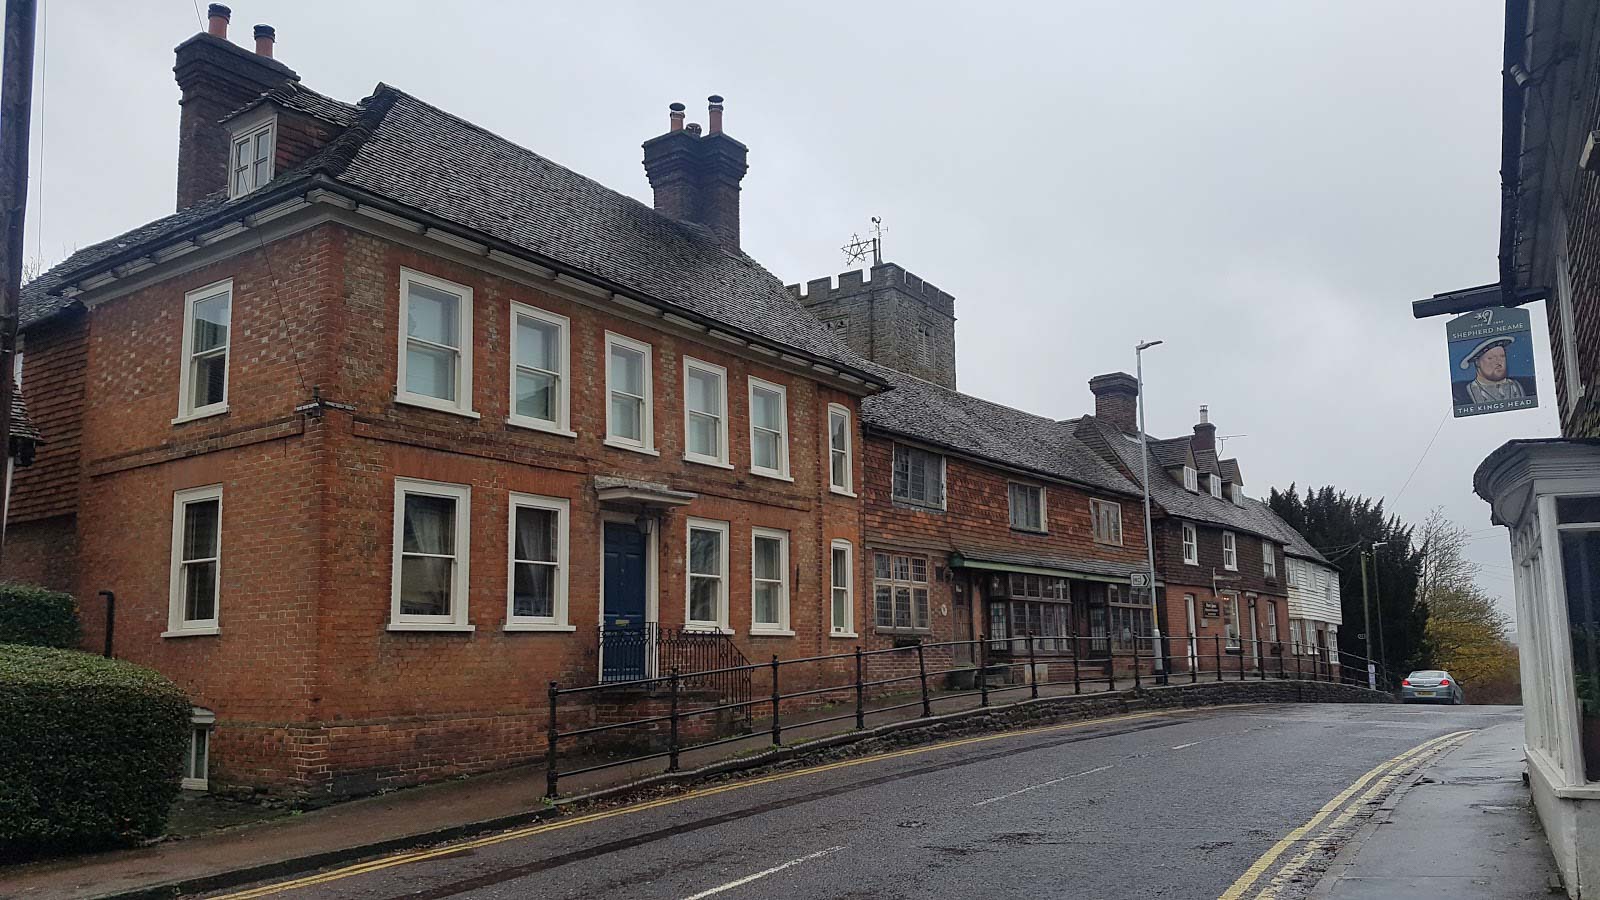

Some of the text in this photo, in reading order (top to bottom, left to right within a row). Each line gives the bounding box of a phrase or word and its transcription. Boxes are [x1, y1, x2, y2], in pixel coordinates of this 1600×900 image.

[1452, 328, 1494, 339] SHEPHERD
[1496, 322, 1524, 332] NEAME
[1457, 399, 1532, 414] THE KINGS HEAD
